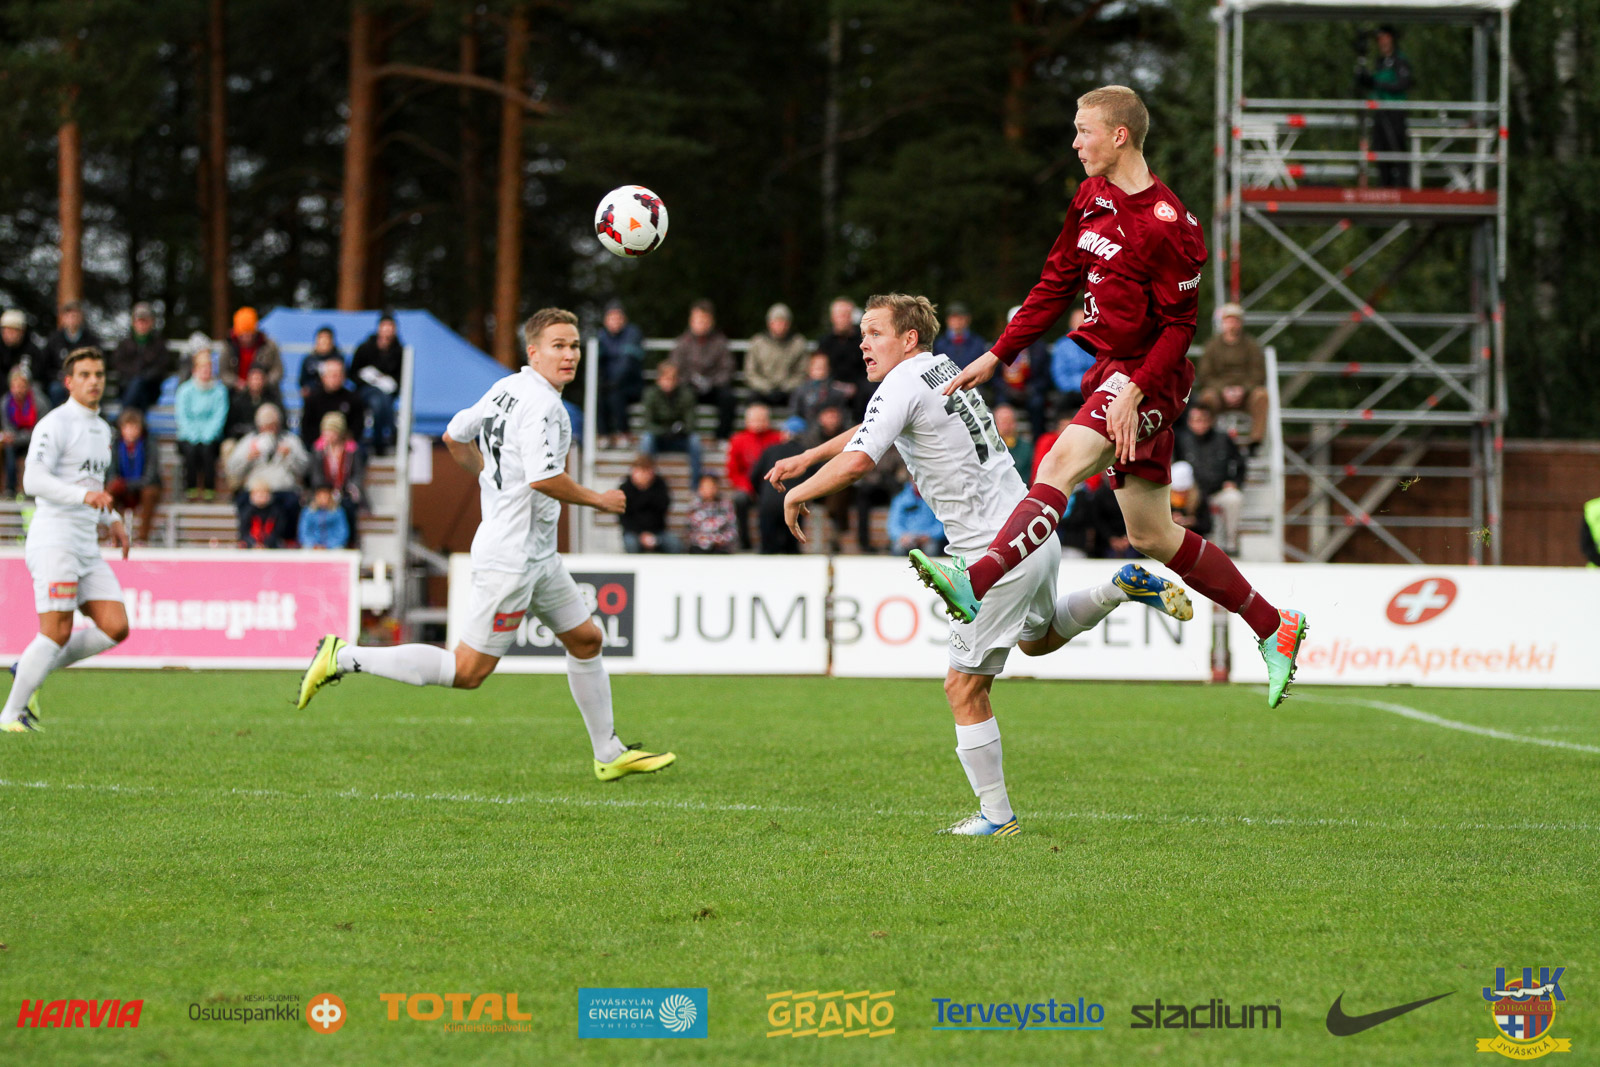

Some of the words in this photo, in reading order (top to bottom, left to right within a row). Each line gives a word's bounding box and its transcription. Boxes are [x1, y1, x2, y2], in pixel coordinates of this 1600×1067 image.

[1077, 230, 1123, 261] ARVIA
[1008, 504, 1060, 560] TOT
[1276, 608, 1299, 660] NIKE
